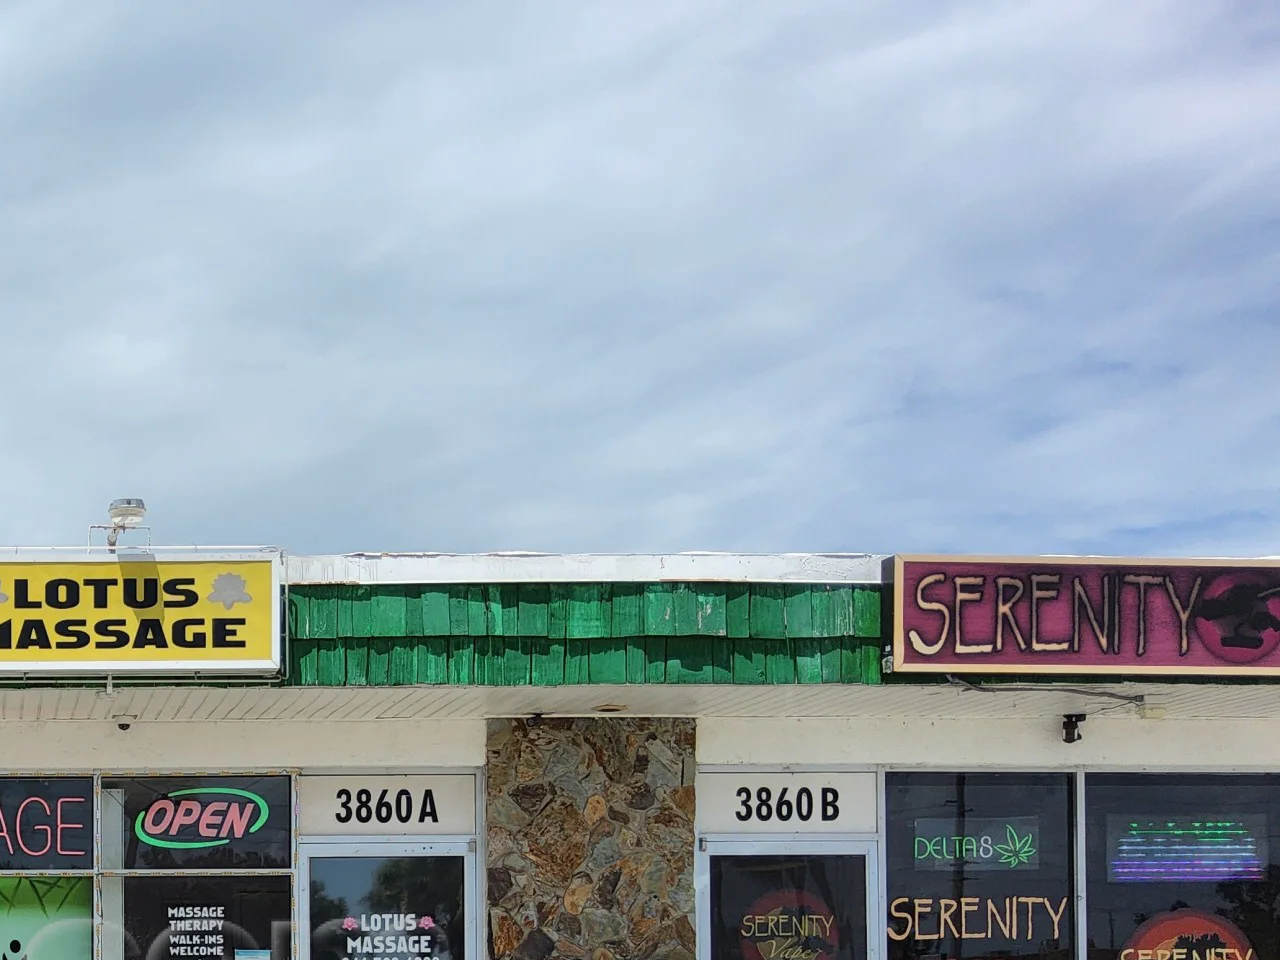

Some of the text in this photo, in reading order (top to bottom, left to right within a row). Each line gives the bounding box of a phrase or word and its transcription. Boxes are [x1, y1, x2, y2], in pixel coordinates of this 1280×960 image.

[13, 577, 199, 610] LOTUS
[908, 573, 1203, 657] SERENITY
[143, 799, 256, 839] OPEN
[167, 906, 225, 918] MASSAGE
[886, 896, 1068, 941] SERENITY
[169, 920, 224, 931] THERAPY
[361, 913, 417, 932] LOTUS
[740, 915, 835, 937] SERENITY
[169, 935, 224, 945] WALK-INS
[346, 935, 432, 954] MASSAGE
[169, 946, 225, 956] WELCOME
